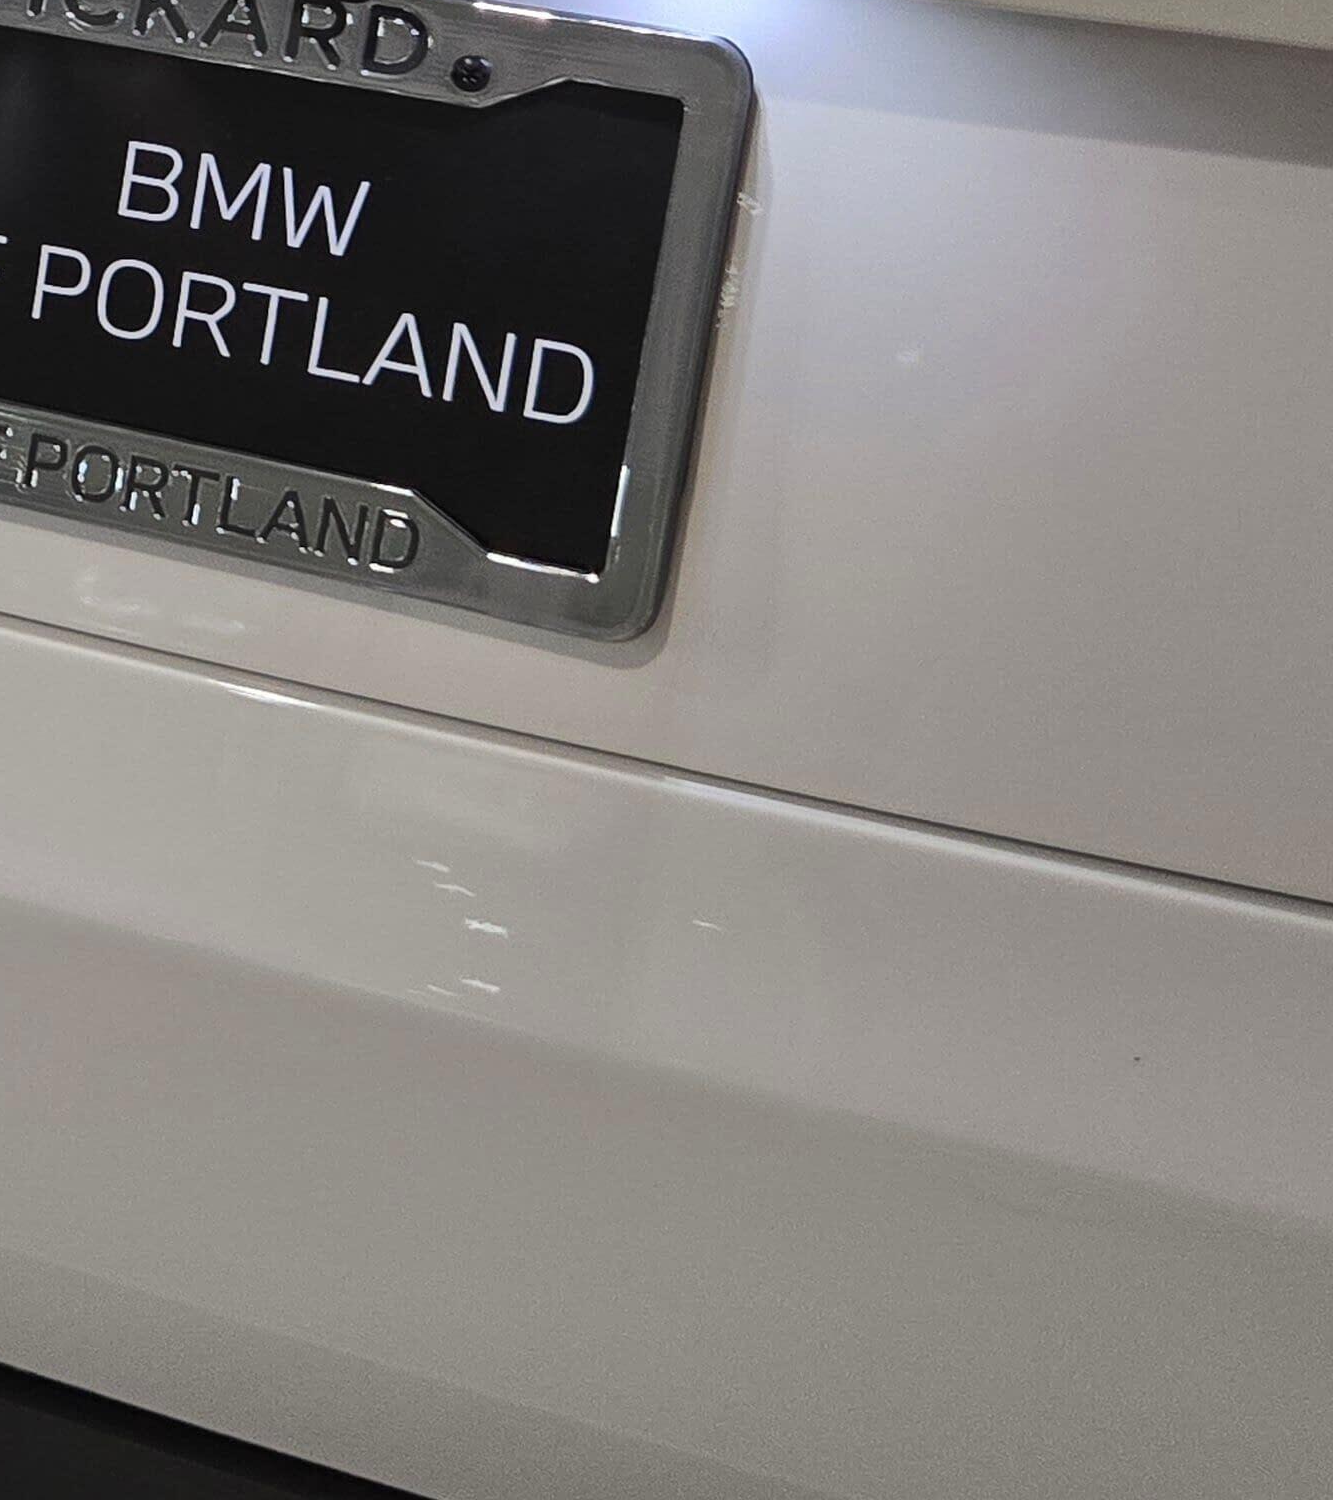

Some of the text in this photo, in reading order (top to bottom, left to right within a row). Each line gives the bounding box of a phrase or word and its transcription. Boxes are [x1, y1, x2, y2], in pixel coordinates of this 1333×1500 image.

[117, 140, 372, 258] BMW
[31, 244, 596, 426] PORTLAND
[23, 430, 423, 573] PORTLAND
